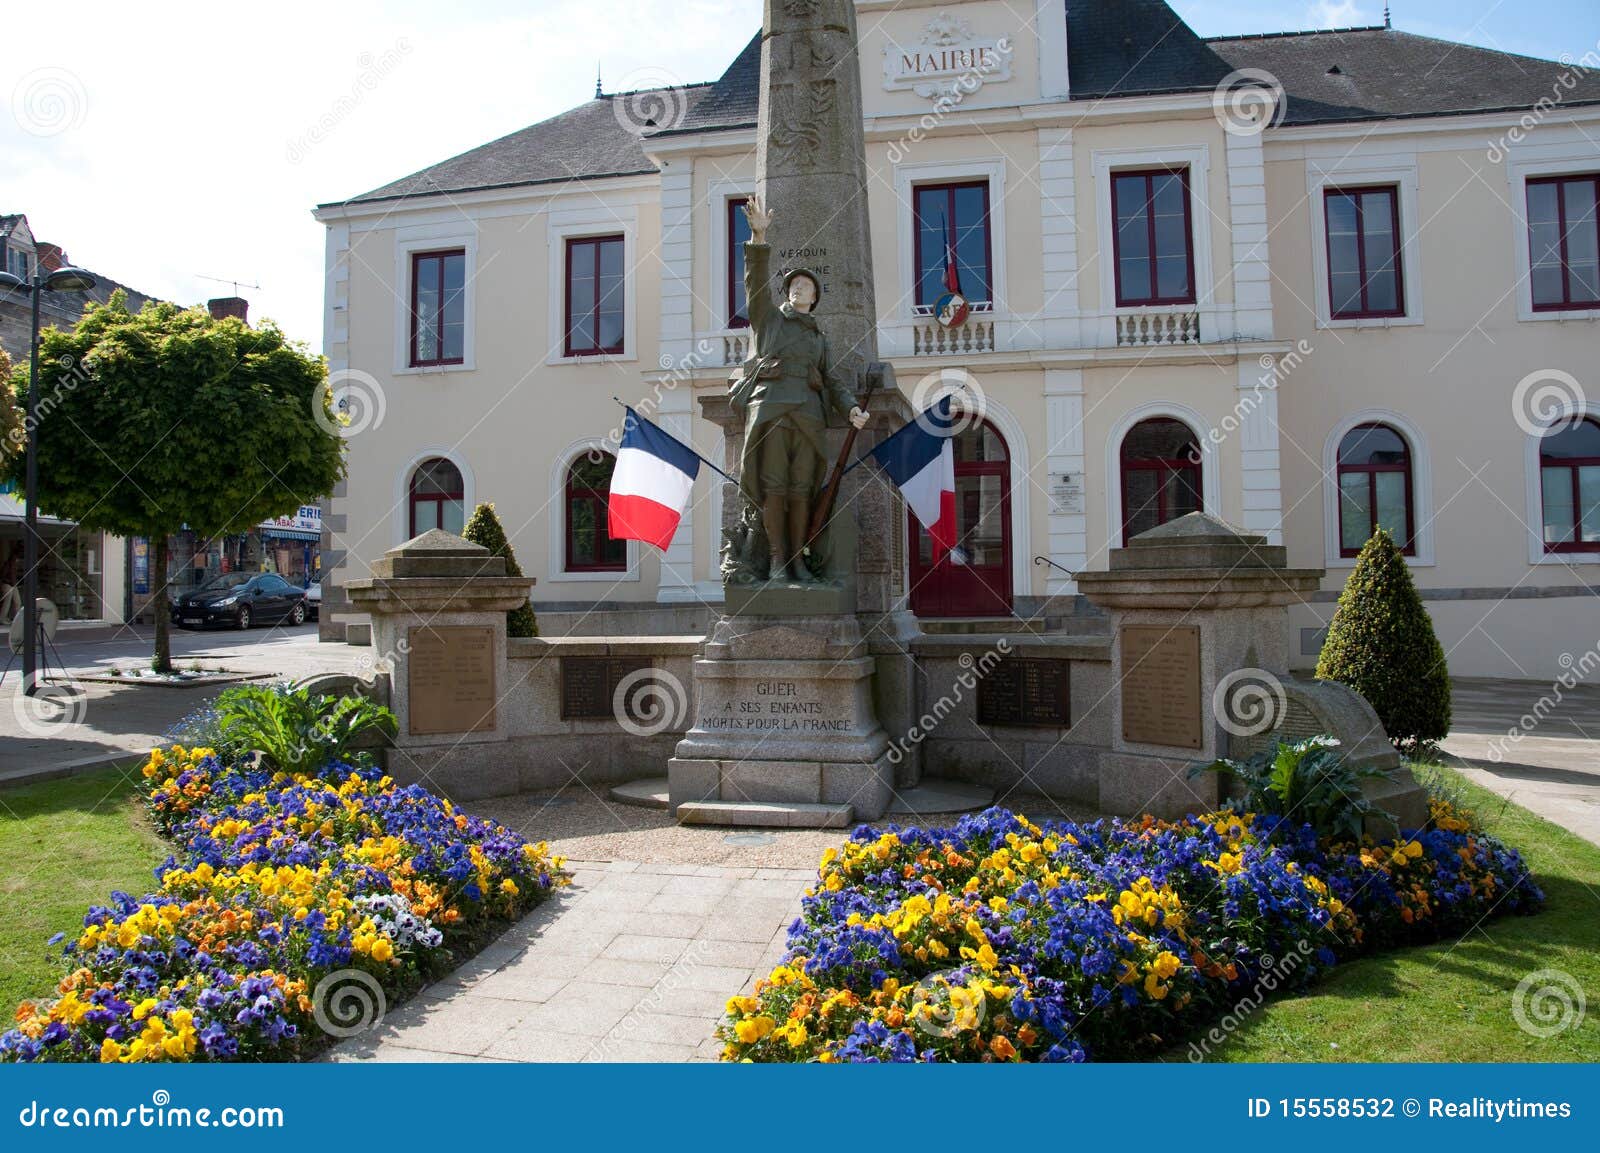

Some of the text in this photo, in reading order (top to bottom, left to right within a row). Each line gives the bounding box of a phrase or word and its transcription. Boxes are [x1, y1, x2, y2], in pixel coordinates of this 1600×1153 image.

[901, 47, 992, 74] MAIRIE
[779, 248, 827, 258] VERDUN
[757, 683, 797, 696] GUER
[724, 702, 823, 713] A SES ENFANTS
[702, 718, 851, 731] MORTS POUR LA FRANCE
